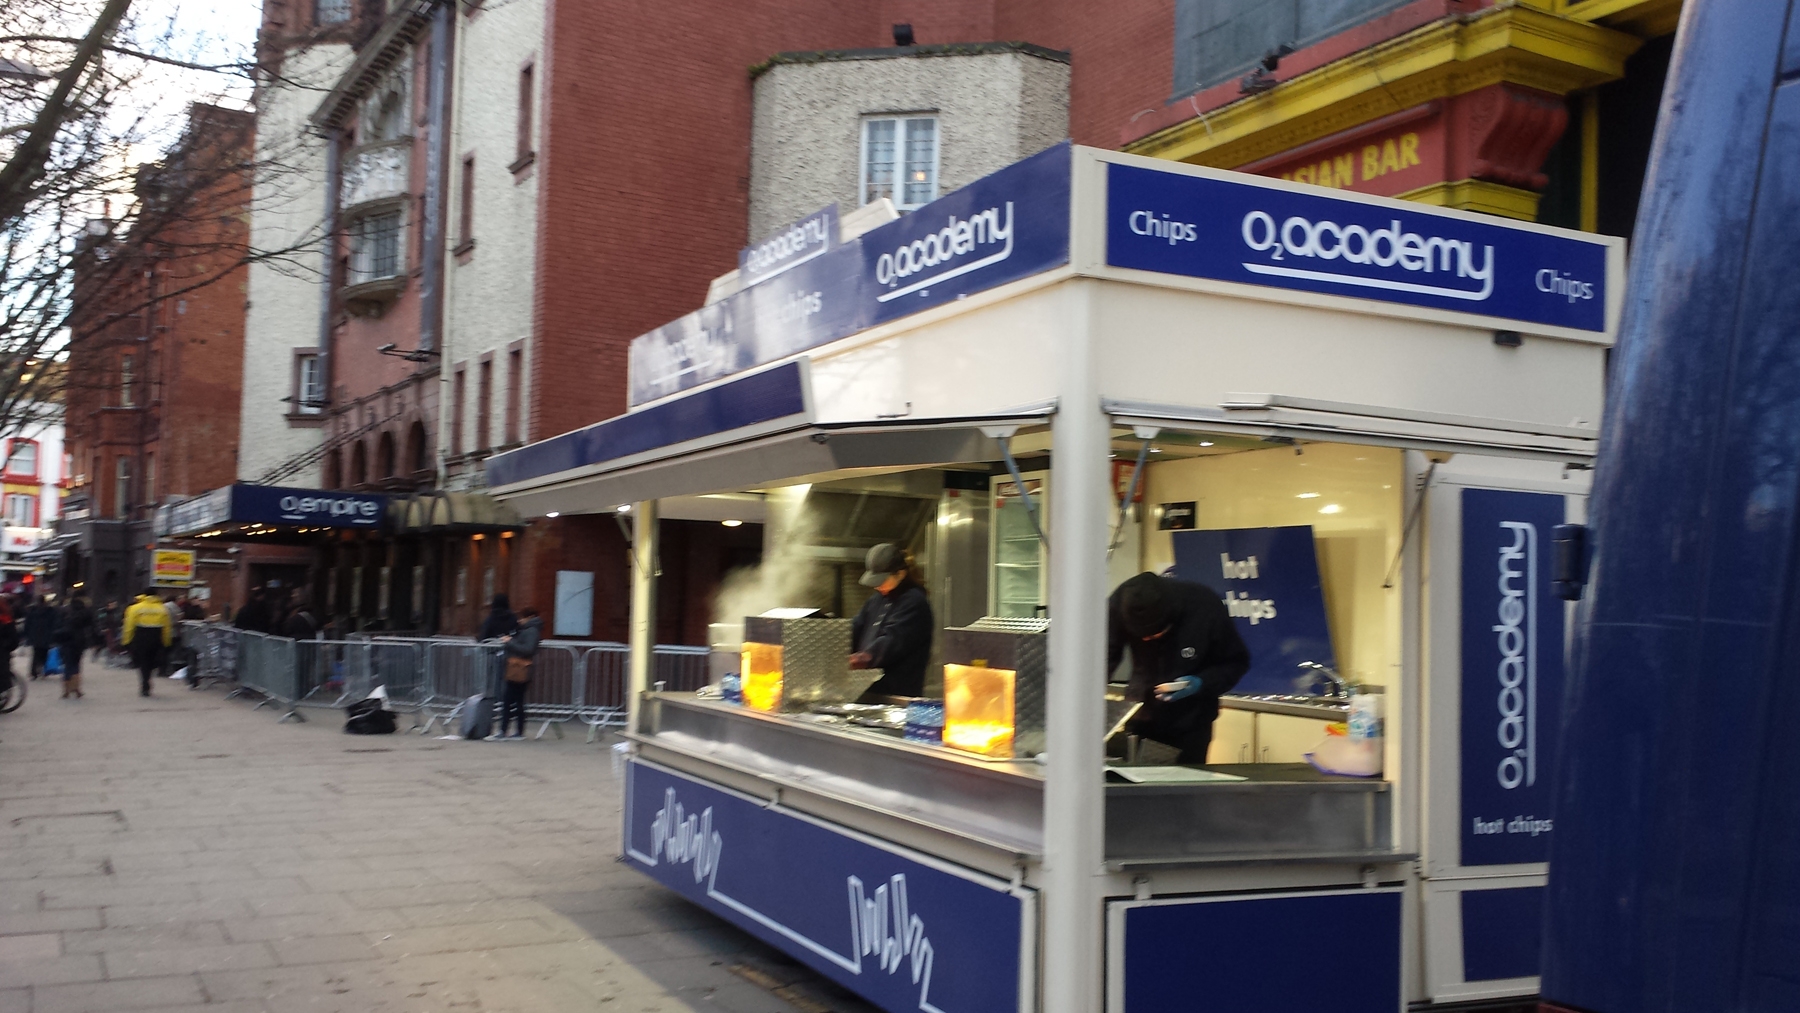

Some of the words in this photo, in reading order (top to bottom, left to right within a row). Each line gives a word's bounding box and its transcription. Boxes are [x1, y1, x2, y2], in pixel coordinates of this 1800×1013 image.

[1281, 153, 1354, 188] SIAN
[1362, 132, 1420, 181] BAR
[1129, 210, 1198, 246] Chips
[1535, 269, 1595, 304] Chips
[1220, 552, 1259, 579] hot
[1221, 590, 1277, 625] hips
[1473, 816, 1504, 835] hot
[1507, 815, 1553, 837] chips
